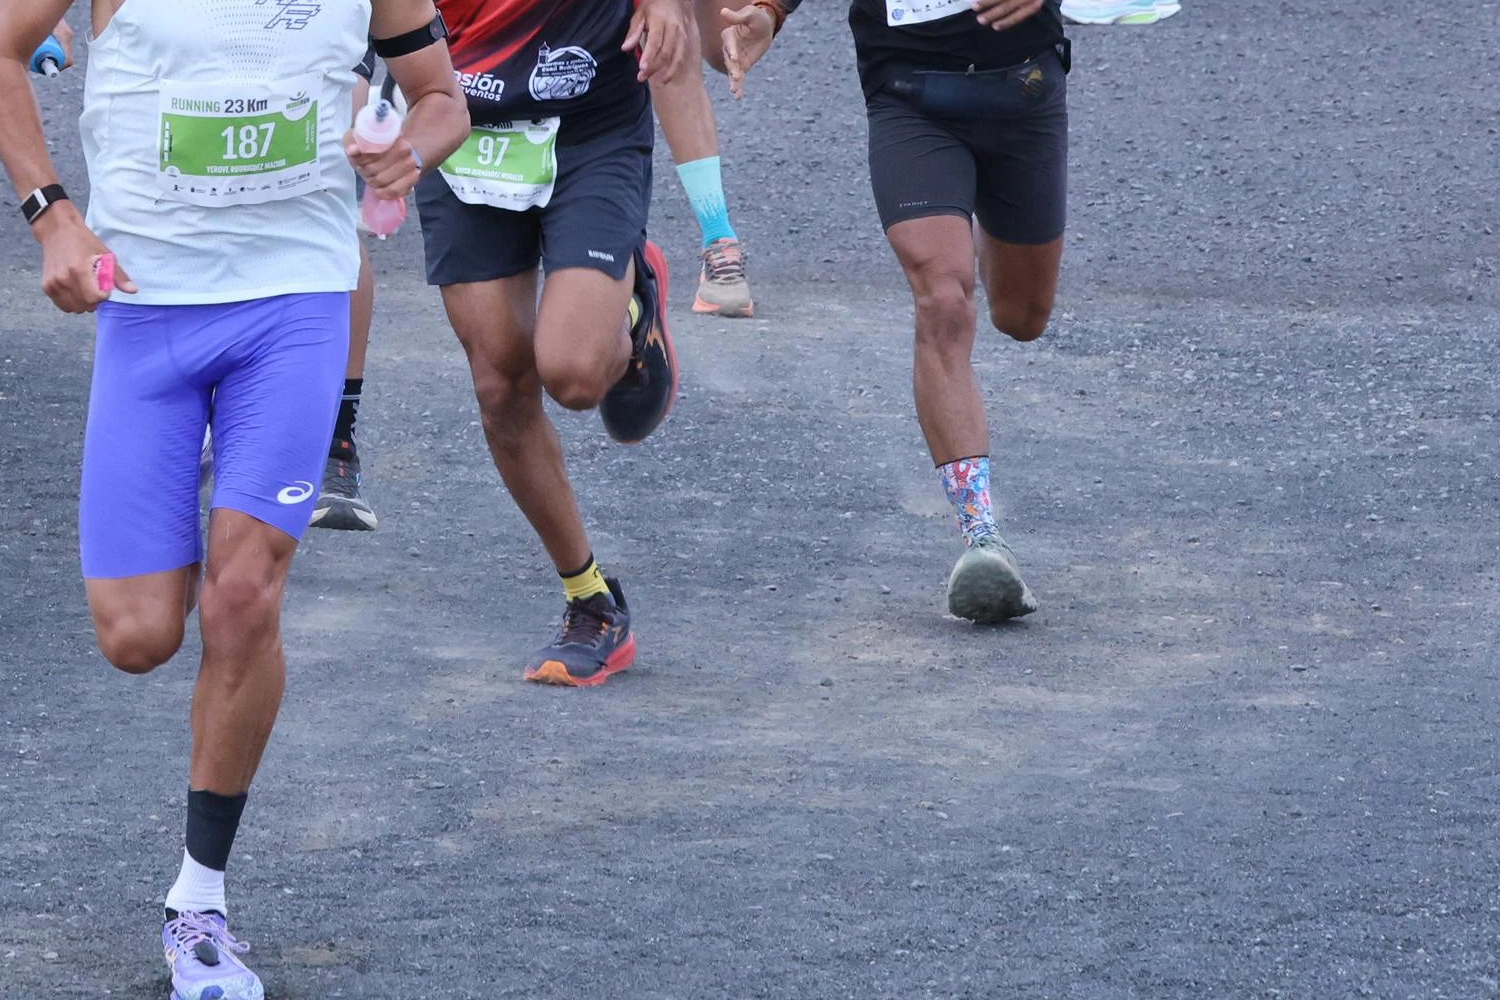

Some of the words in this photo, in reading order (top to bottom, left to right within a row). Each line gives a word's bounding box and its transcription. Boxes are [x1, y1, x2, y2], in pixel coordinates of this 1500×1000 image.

[171, 97, 221, 113] RUNNING
[224, 99, 245, 114] 23
[247, 98, 268, 112] Km
[220, 121, 276, 160] 187
[477, 135, 511, 167] 97
